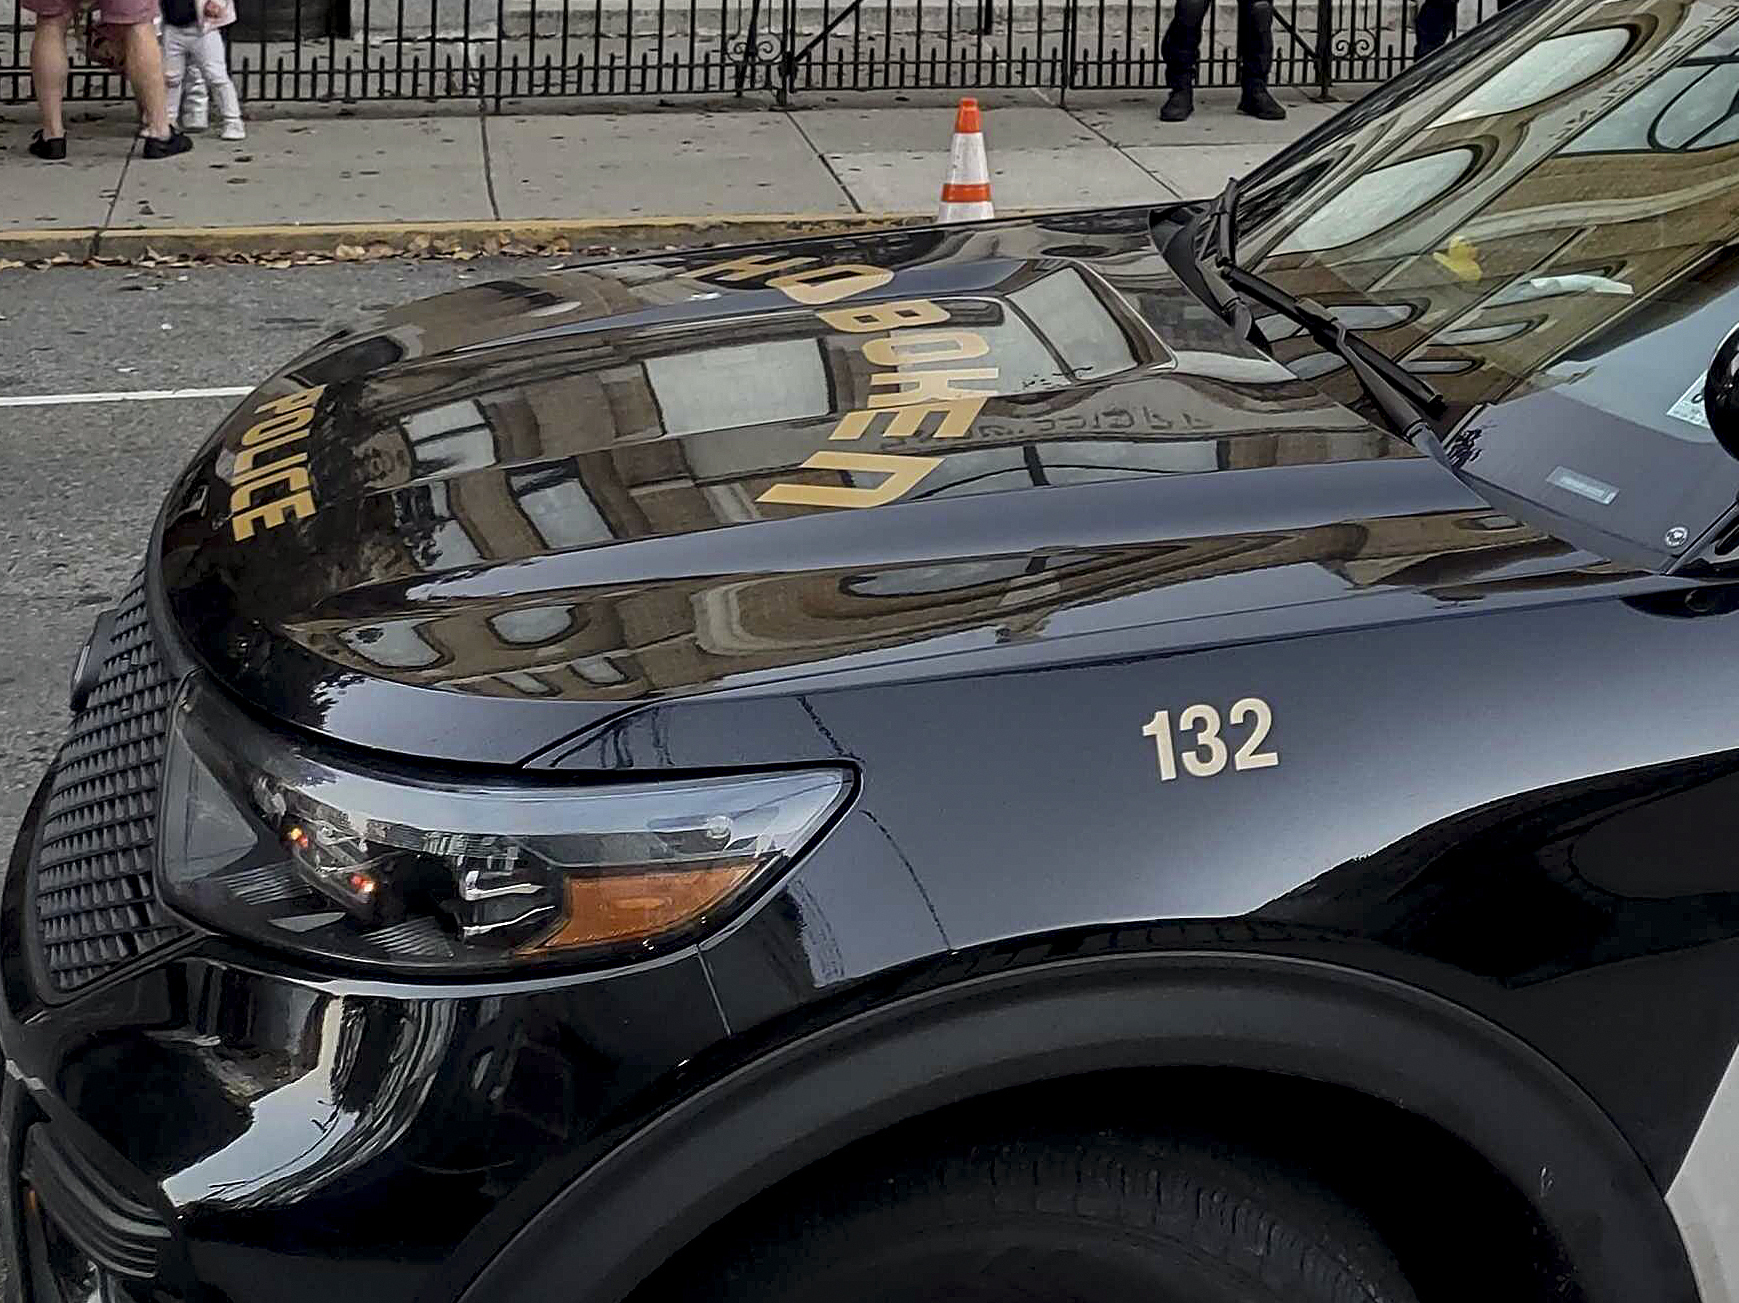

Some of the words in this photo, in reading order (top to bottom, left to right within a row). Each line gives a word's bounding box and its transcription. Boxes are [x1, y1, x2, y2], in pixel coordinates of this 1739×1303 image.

[676, 254, 999, 508] HOBOKEN
[230, 383, 329, 543] POLICE
[1142, 697, 1279, 781] 132
